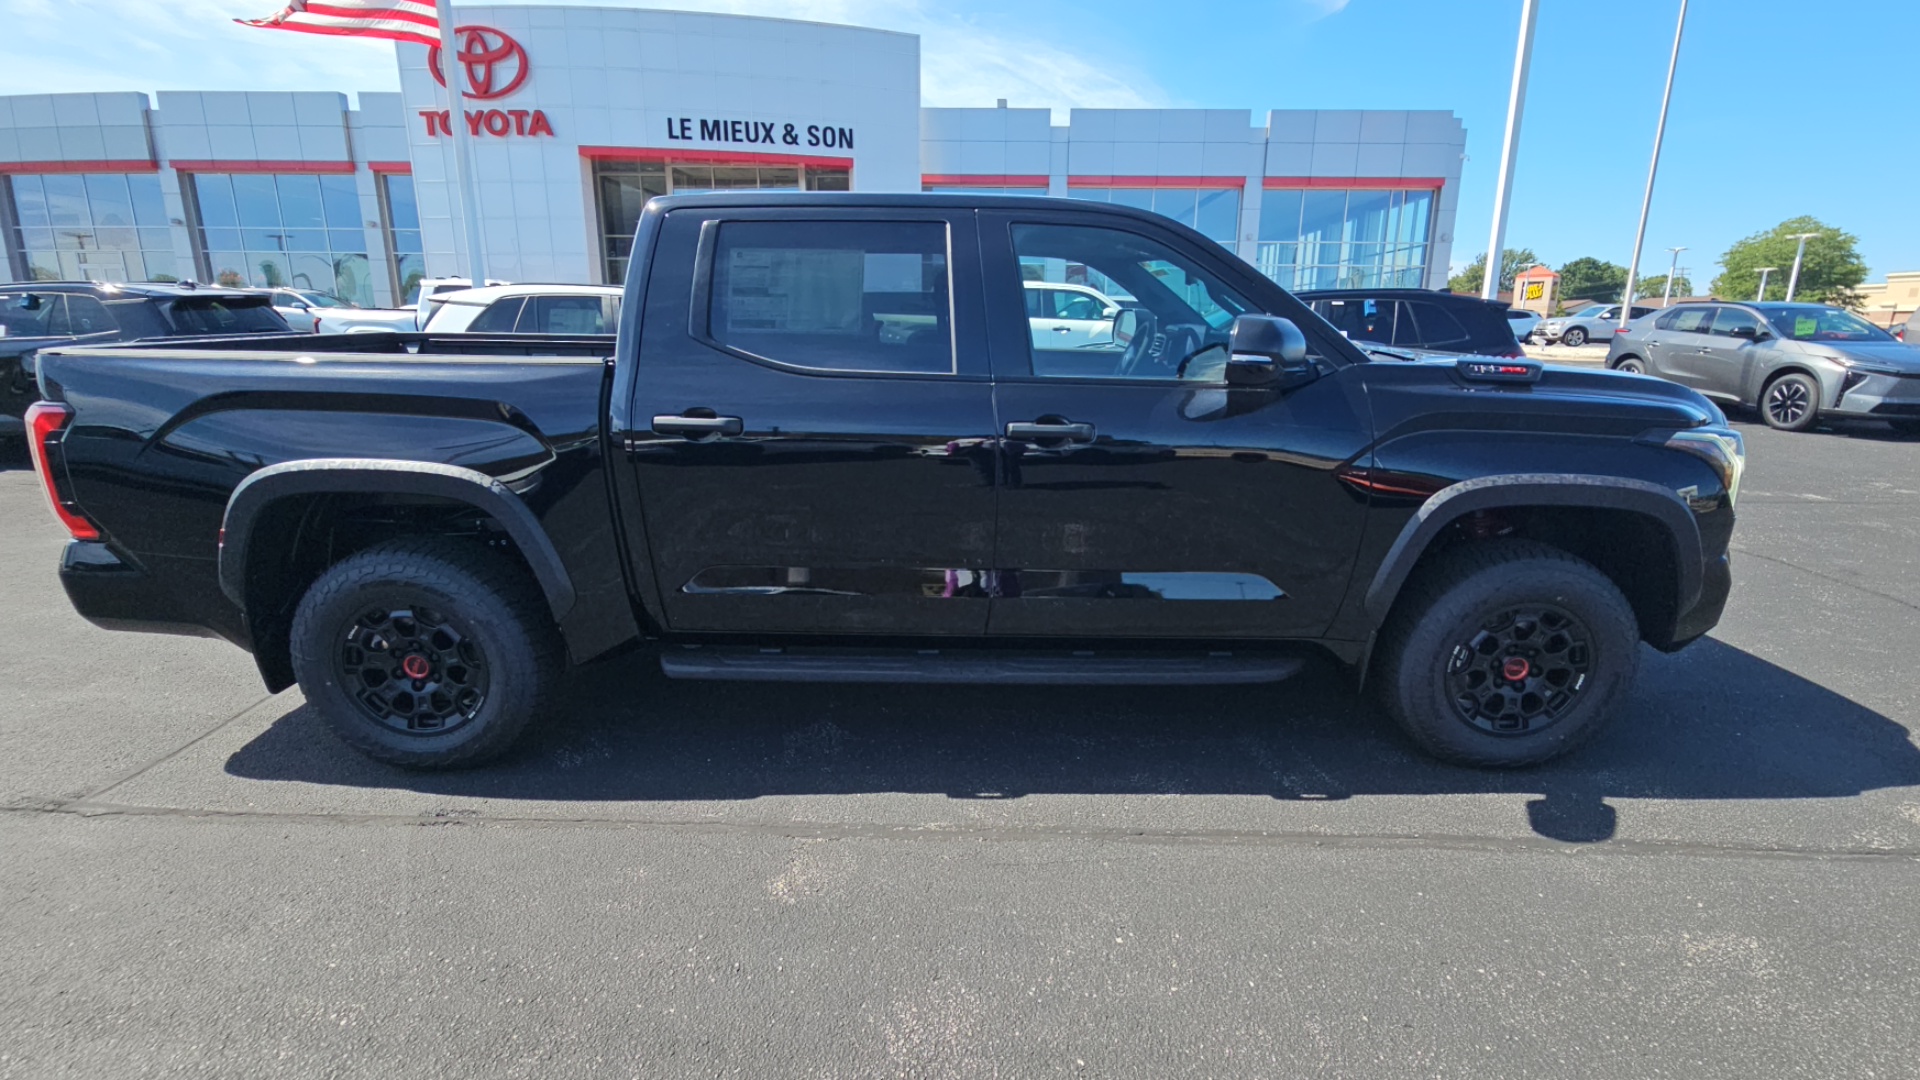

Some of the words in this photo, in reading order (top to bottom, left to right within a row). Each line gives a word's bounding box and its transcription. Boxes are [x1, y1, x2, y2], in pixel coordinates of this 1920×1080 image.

[667, 117, 693, 141] LE
[700, 119, 776, 145] MIEUX
[782, 123, 800, 146] &
[807, 125, 854, 149] SON
